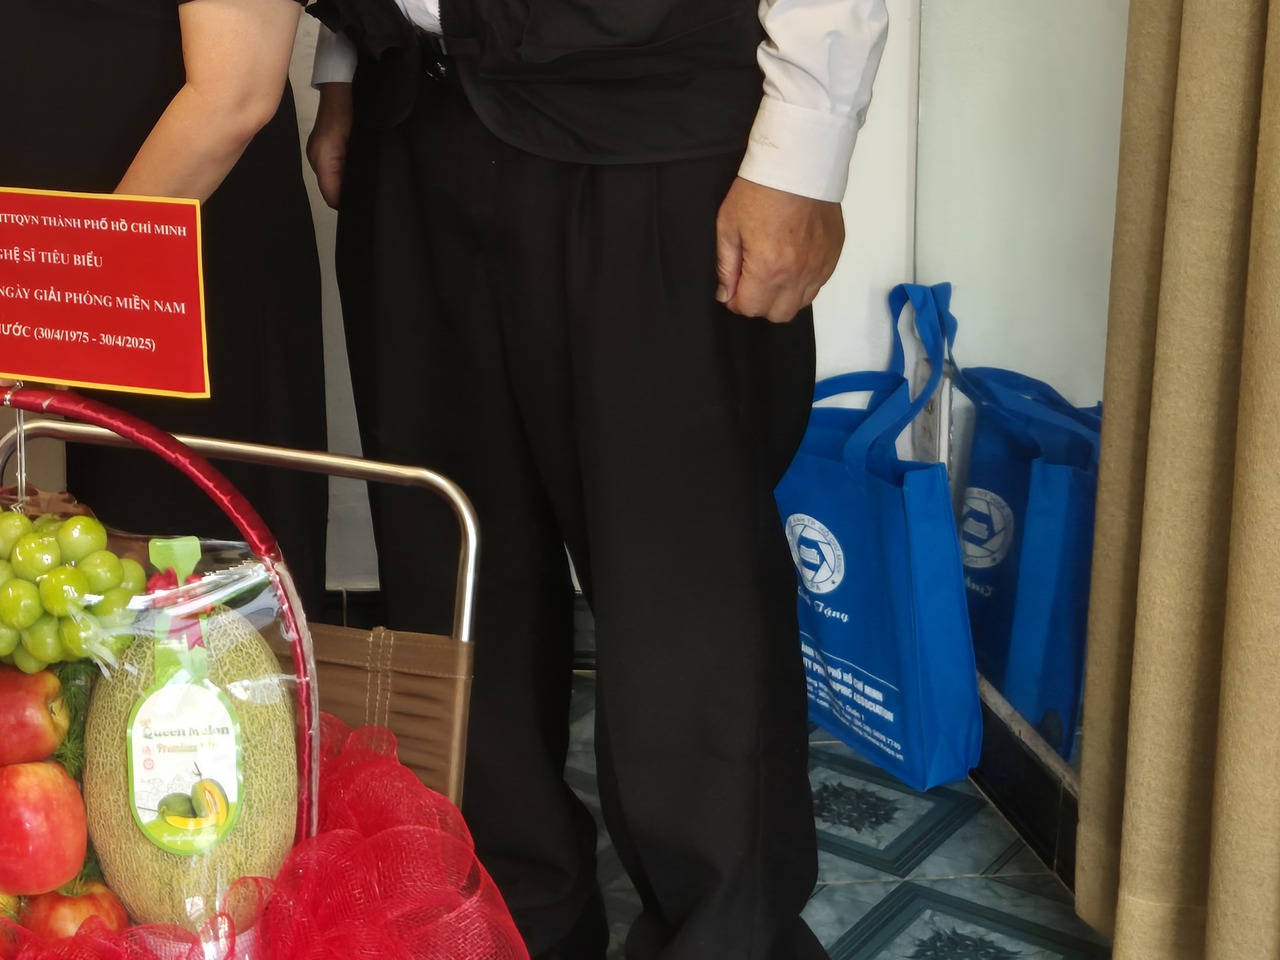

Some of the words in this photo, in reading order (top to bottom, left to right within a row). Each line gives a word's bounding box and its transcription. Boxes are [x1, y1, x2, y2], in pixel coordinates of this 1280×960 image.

[41, 214, 82, 229] THÀNH
[84, 217, 108, 230] PHỐ
[111, 218, 128, 232] HỒ
[130, 221, 152, 234] CHÍ
[154, 224, 187, 237] MINH
[38, 249, 70, 265] TIÊU
[33, 286, 61, 302] GIẢI
[64, 290, 113, 308] PHÓNG
[115, 293, 151, 311] MIỀN
[153, 299, 186, 315] NAM
[34, 327, 89, 343] (30/4/1975
[99, 333, 156, 352] 30/4/2025)
[142, 726, 186, 740] Queen
